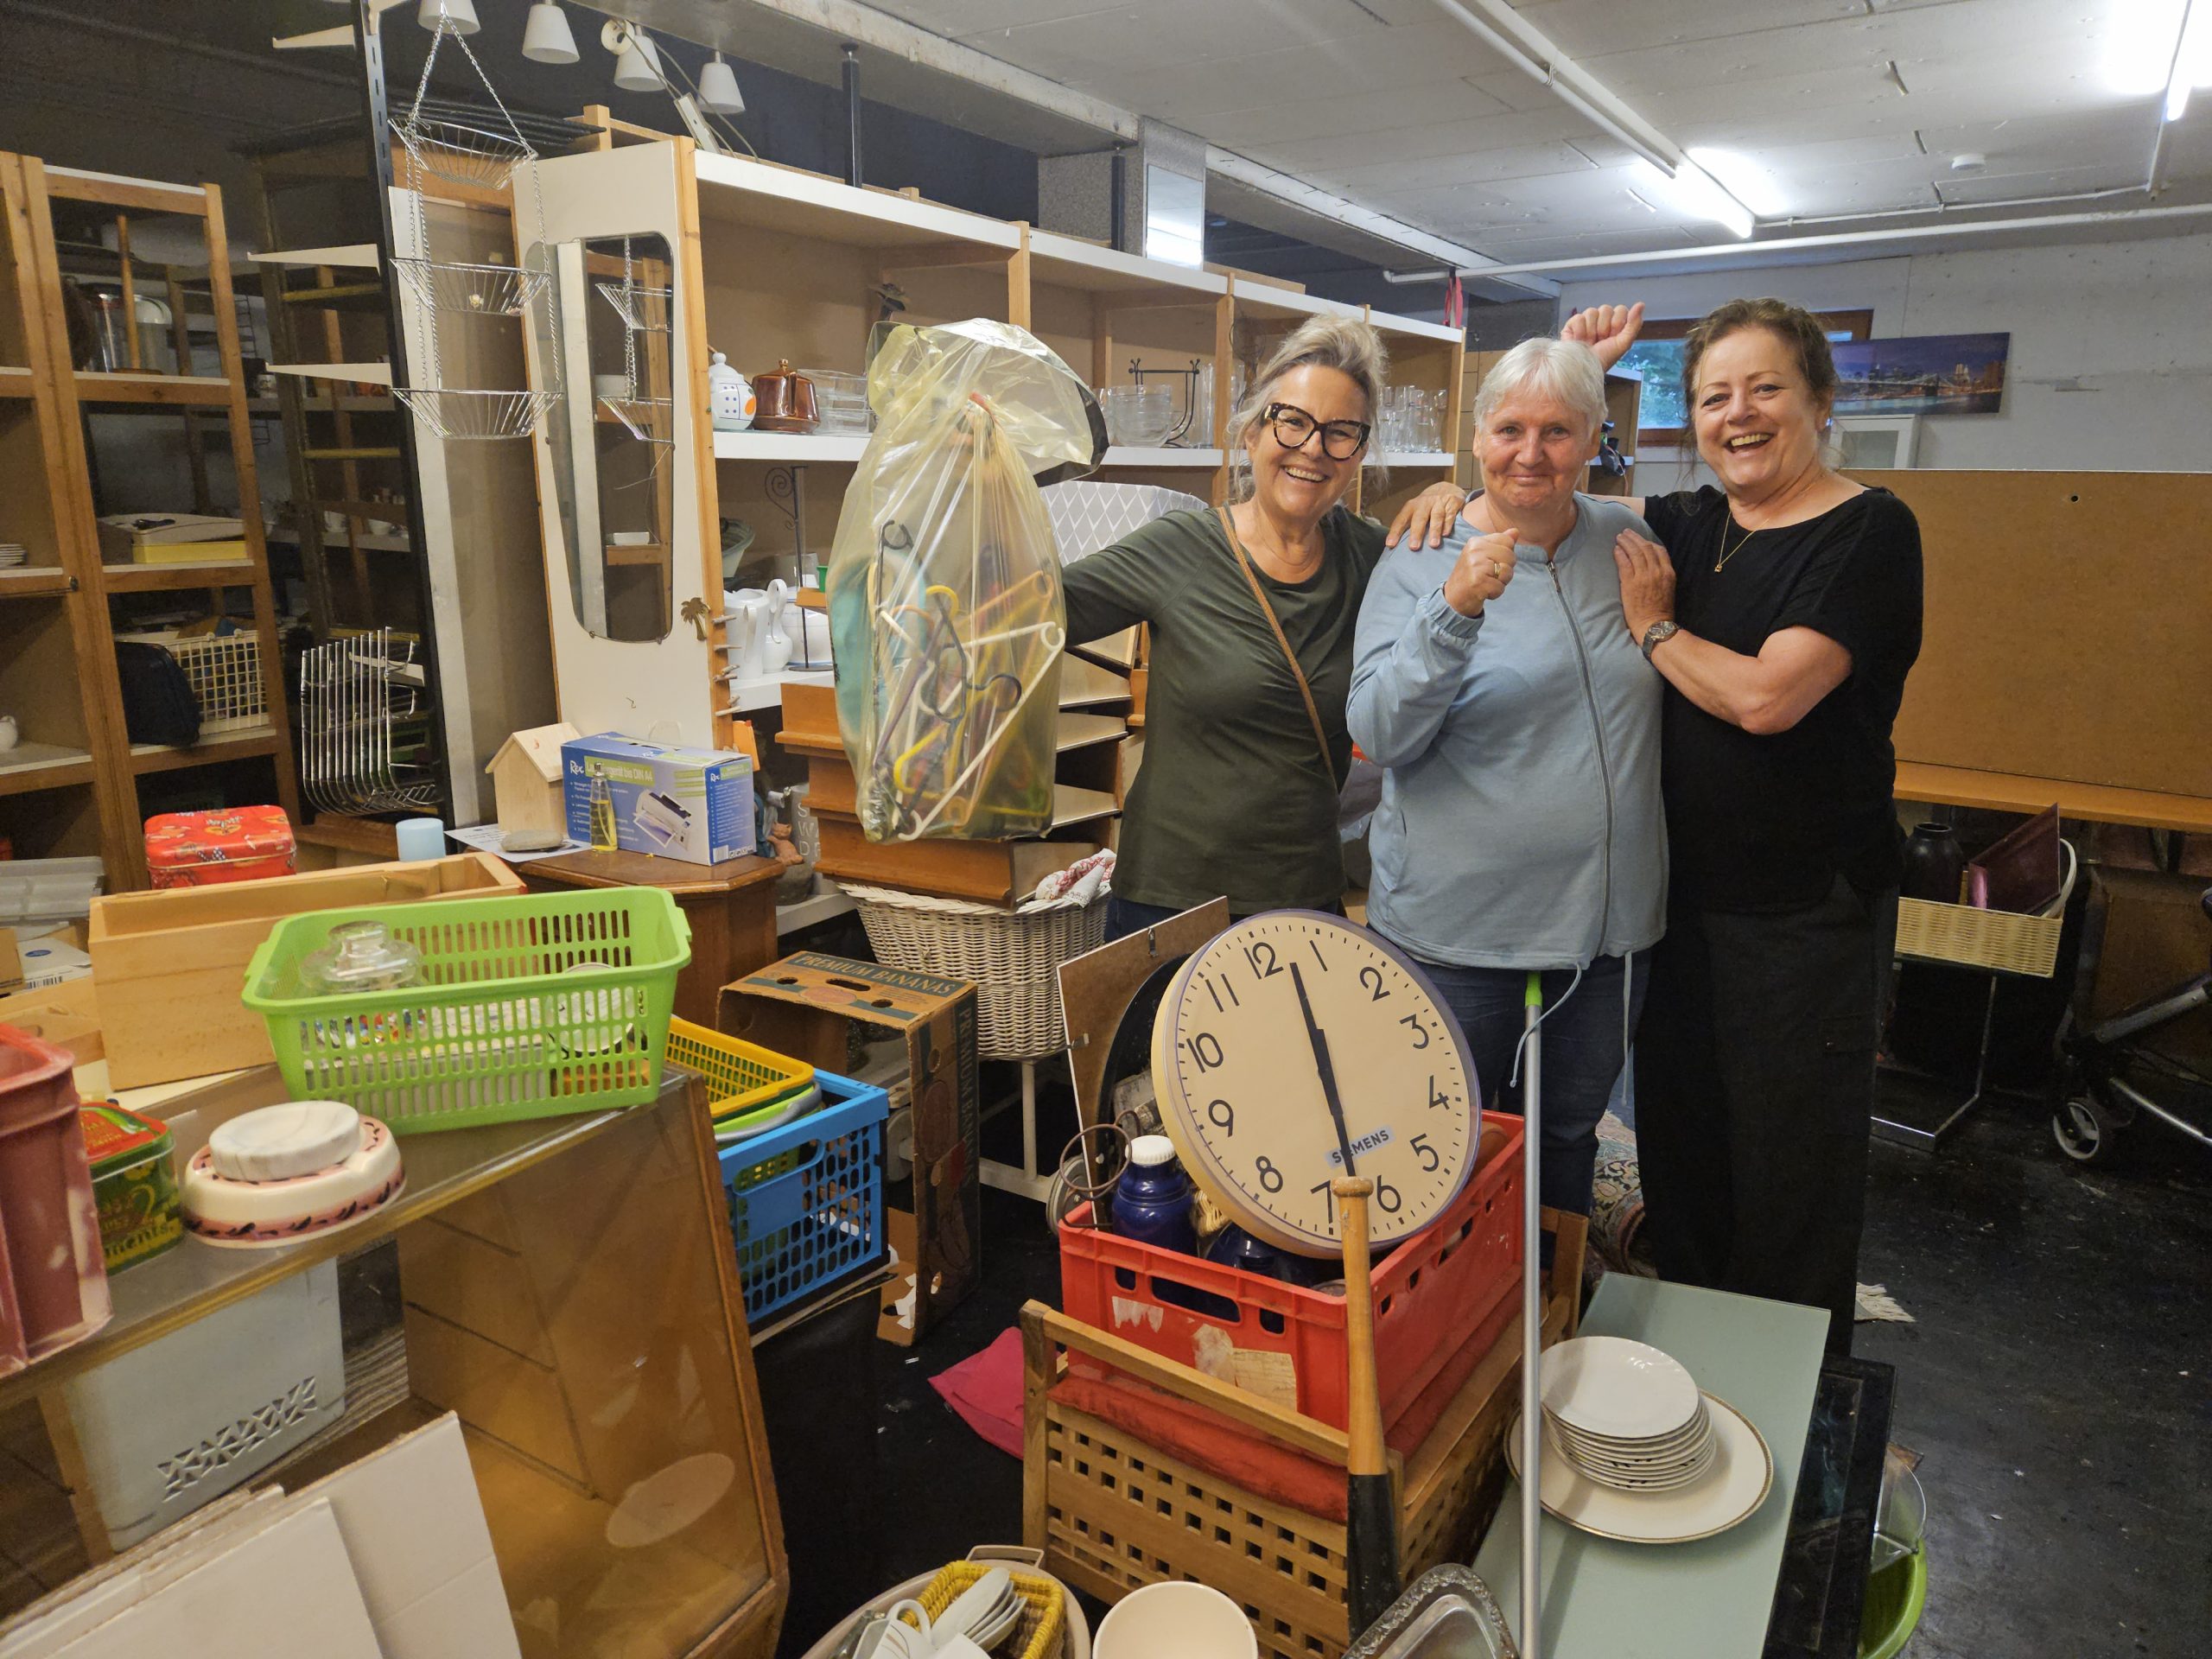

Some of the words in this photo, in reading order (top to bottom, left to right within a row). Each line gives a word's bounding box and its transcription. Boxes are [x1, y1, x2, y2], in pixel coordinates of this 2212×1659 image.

[1243, 942, 1284, 980] 12
[1309, 939, 1329, 972] 1
[795, 955, 869, 977] PREMIUM
[873, 969, 953, 995] BANANAS
[1205, 973, 1240, 1013] 11
[1358, 966, 1391, 1002] 2
[1399, 1014, 1430, 1050] 3
[959, 1007, 974, 1097] PREMIUM
[1186, 1032, 1224, 1074] 10
[1428, 1074, 1450, 1110] 4
[1208, 1098, 1235, 1138] 9
[1332, 1129, 1389, 1164] SMENS
[1409, 1133, 1440, 1173] 5
[1255, 1155, 1284, 1193] 8
[1310, 1179, 1334, 1224] 7
[1376, 1174, 1402, 1213] 6
[105, 1223, 175, 1256] ments.
